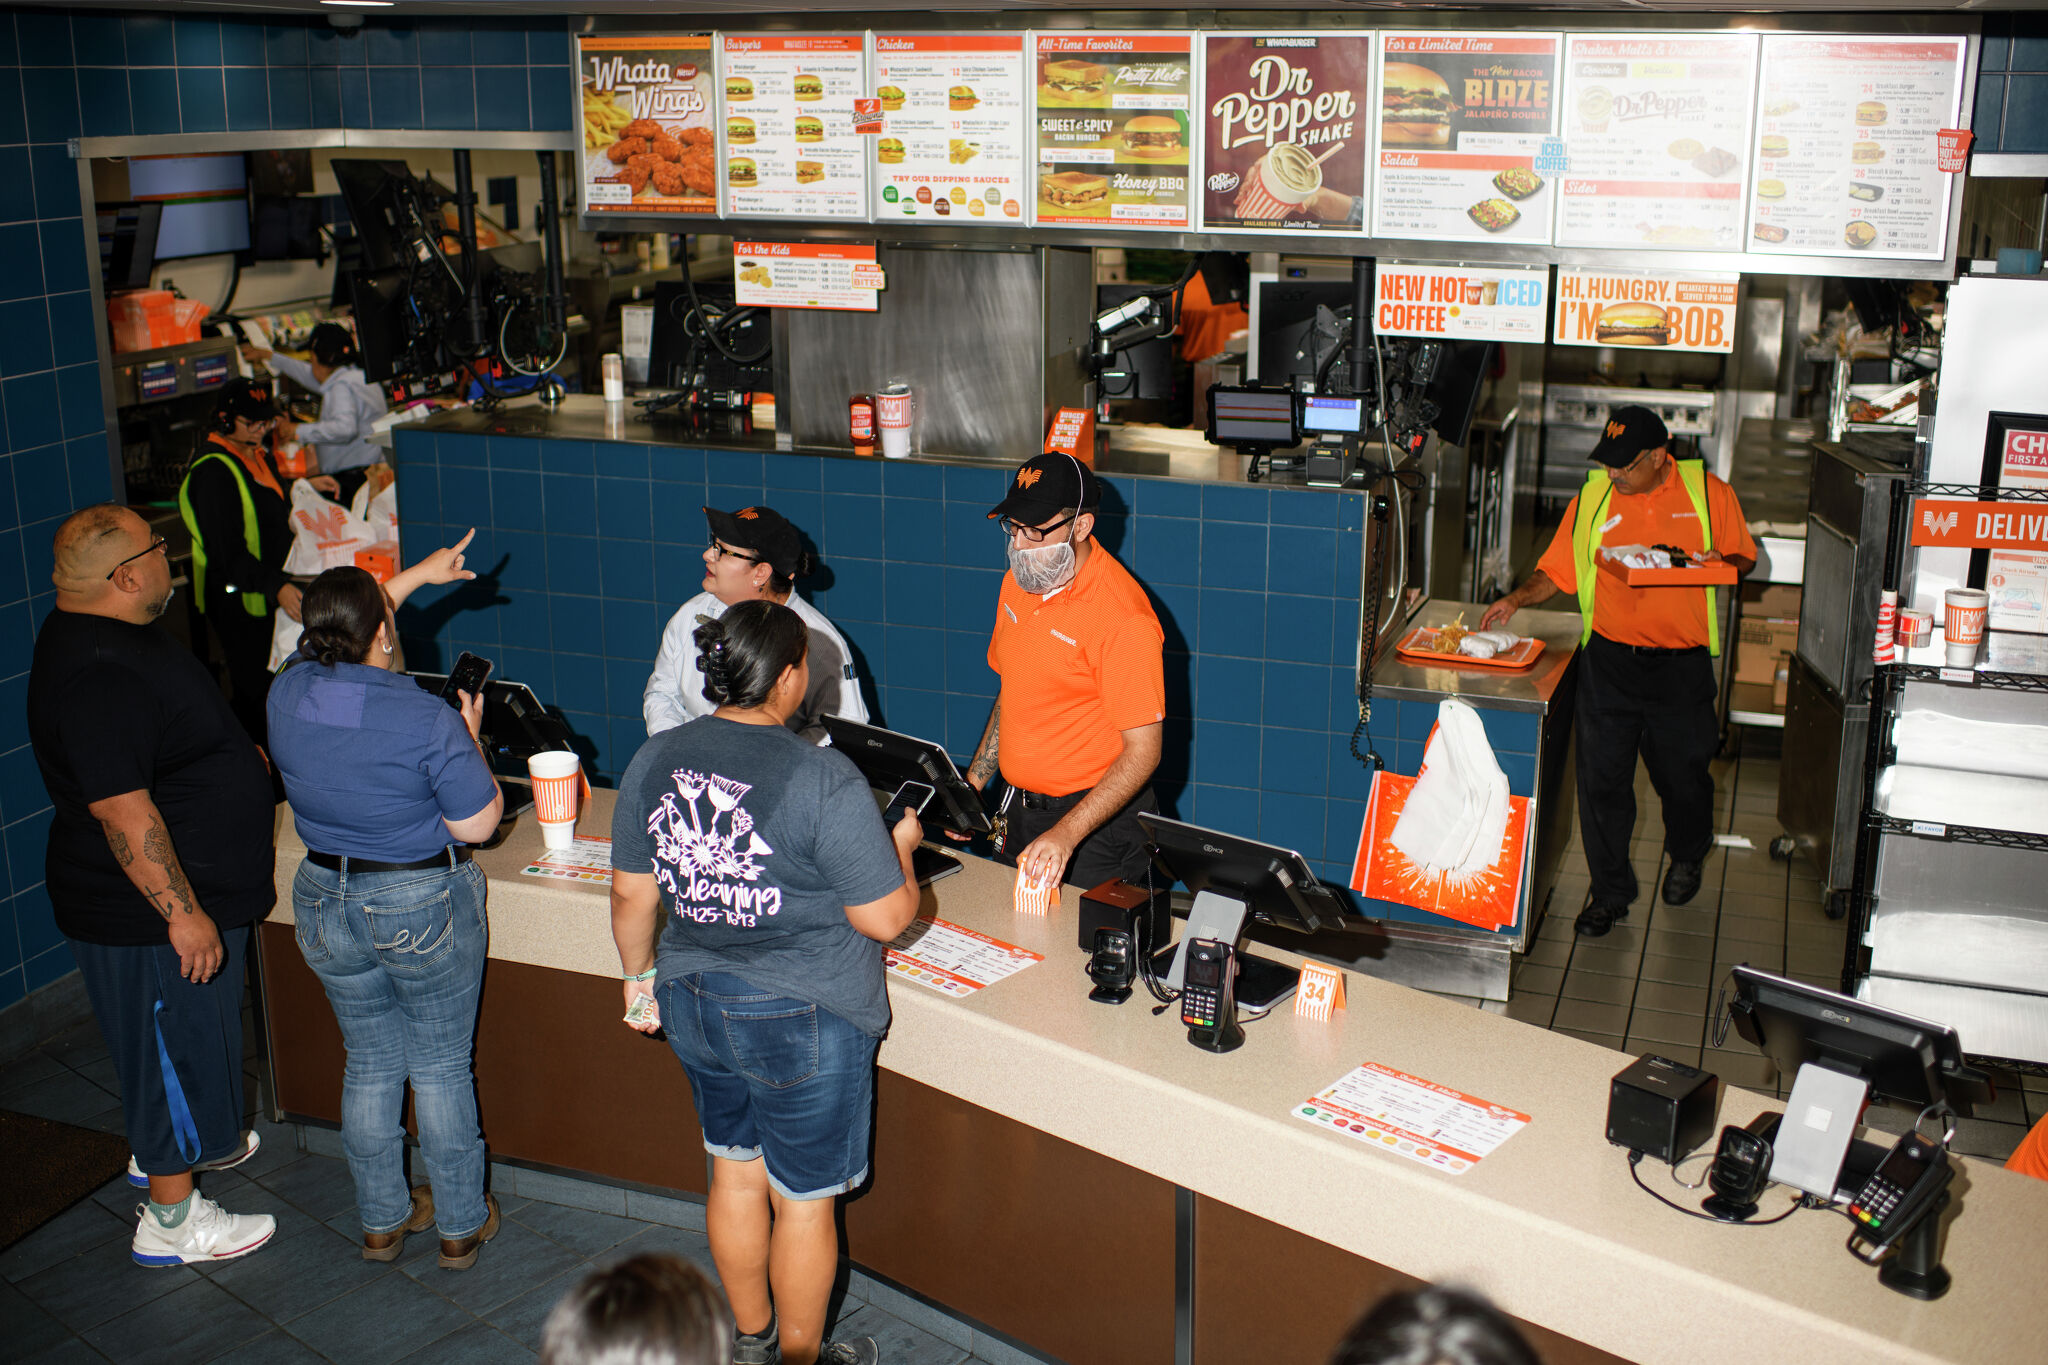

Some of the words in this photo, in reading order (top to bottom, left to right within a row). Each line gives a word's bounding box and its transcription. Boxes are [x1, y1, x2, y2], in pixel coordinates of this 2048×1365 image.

[725, 38, 761, 55] Burgers
[877, 38, 914, 50] Chicken
[1039, 38, 1083, 50] All-Time
[1086, 38, 1134, 50] Favorites
[1266, 38, 1317, 47] WHATABURGER
[1387, 38, 1407, 50] For
[1408, 40, 1415, 50] a
[1419, 38, 1463, 51] Limited
[1465, 39, 1494, 51] Time
[1573, 44, 1616, 57] Shakes,
[1618, 44, 1652, 56] Malts
[590, 57, 672, 91] Whata
[1114, 66, 1154, 87] Patty
[1250, 56, 1313, 101] Dr
[1473, 68, 1489, 77] THE
[1513, 69, 1544, 77] BACON
[1464, 78, 1549, 108] BLAZE
[614, 85, 705, 119] Wings
[1640, 91, 1709, 120] Pepper
[1212, 90, 1356, 149] Pepper
[1464, 110, 1510, 119] JALAPEÑO
[1511, 111, 1547, 120] DOUBLE
[1041, 119, 1076, 132] SWEET
[1084, 119, 1113, 132] SPICY
[1300, 121, 1354, 148] SHAKE
[1542, 142, 1564, 156] ICED
[1940, 137, 1958, 148] NEW
[1382, 153, 1419, 167] Salads
[1940, 148, 1953, 158] HOT
[1534, 156, 1569, 170] COFFEE
[1940, 158, 1964, 170] COFFEE
[974, 176, 1010, 184] SAUCES
[1113, 173, 1158, 197] Honey
[1159, 177, 1184, 191] BBQ
[1566, 183, 1597, 194] Sides
[738, 244, 752, 254] For
[754, 245, 769, 255] the
[771, 245, 790, 256] Kids
[1380, 274, 1425, 302] NEW
[1430, 276, 1468, 304] HOT
[1497, 278, 1543, 307] ICED
[1561, 276, 1585, 301] HI,
[1588, 278, 1671, 302] HUNGRY.
[1678, 285, 1708, 293] BREAKFAST
[1722, 286, 1735, 294] BUN
[1379, 303, 1446, 332] COFFEE
[1559, 301, 1603, 340] I'M
[1666, 306, 1730, 347] BOB.
[2012, 435, 2048, 454] CH
[2008, 454, 2038, 464] FIRST
[1305, 982, 1326, 1003] 34
[1366, 1063, 1396, 1079] Drinks,
[1398, 1072, 1426, 1088] Shakes
[1426, 1081, 1435, 1090] &
[1436, 1085, 1463, 1100] Malts
[1311, 1098, 1354, 1118] Signature
[1355, 1112, 1385, 1130] Sauces
[1385, 1123, 1395, 1133] &
[1395, 1127, 1439, 1148] Dressings
